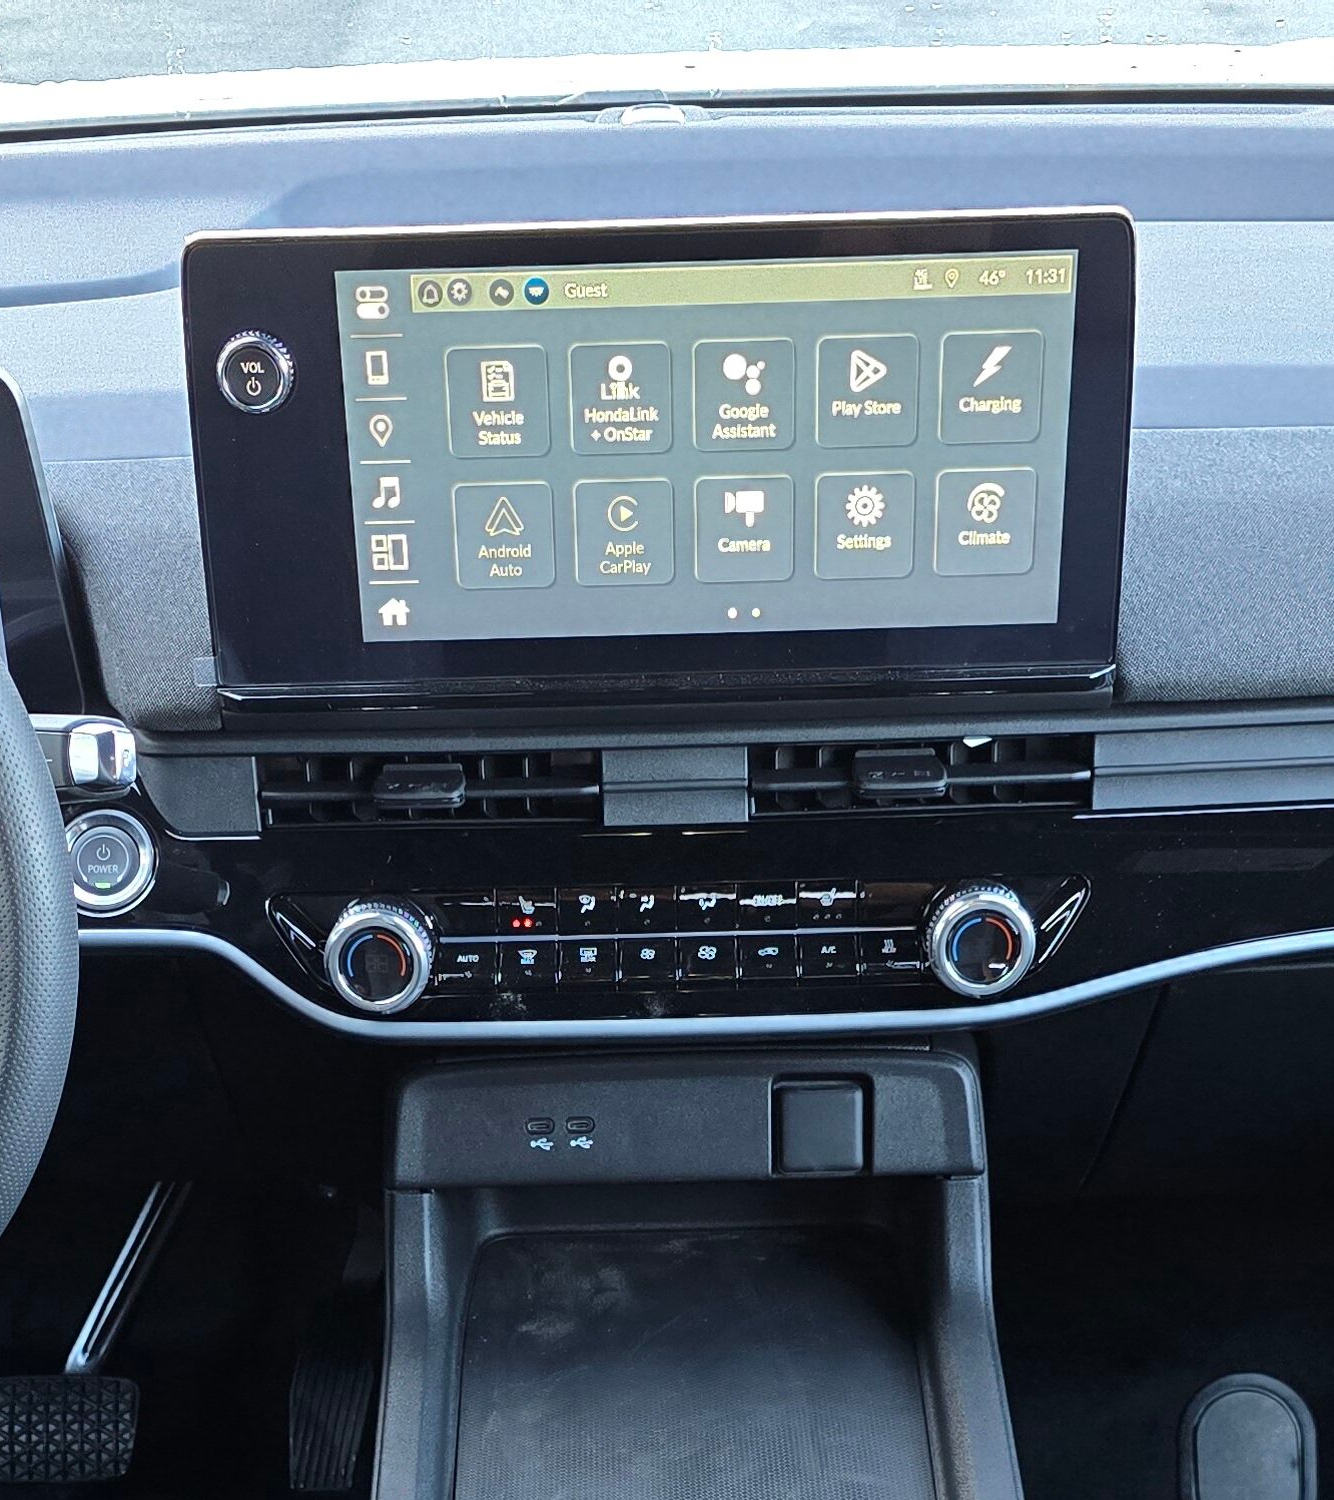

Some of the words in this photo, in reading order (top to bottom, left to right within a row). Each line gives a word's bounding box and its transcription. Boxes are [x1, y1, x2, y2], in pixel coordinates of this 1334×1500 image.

[979, 270, 1006, 286] 46°
[1026, 268, 1066, 285] 11:31
[564, 282, 608, 299] Guest
[240, 362, 265, 374] VOL
[719, 403, 769, 421] Google
[832, 400, 862, 418] Play
[864, 399, 902, 416] Store
[959, 396, 1022, 414] Charging
[472, 411, 524, 427] Vehicle
[584, 406, 659, 424] HondaLink
[478, 430, 522, 446] Status
[603, 427, 653, 443] OnStar
[712, 423, 776, 440] Assistant
[718, 537, 771, 553] Camera
[836, 534, 892, 551] Settings
[958, 530, 1011, 546] Climate
[478, 544, 531, 559] Android
[605, 541, 645, 557] Apple
[489, 563, 523, 577] Auto
[599, 559, 651, 575] CarPlay
[88, 864, 118, 874] POWER
[821, 946, 837, 954] A/C
[456, 954, 479, 963] AUTO
